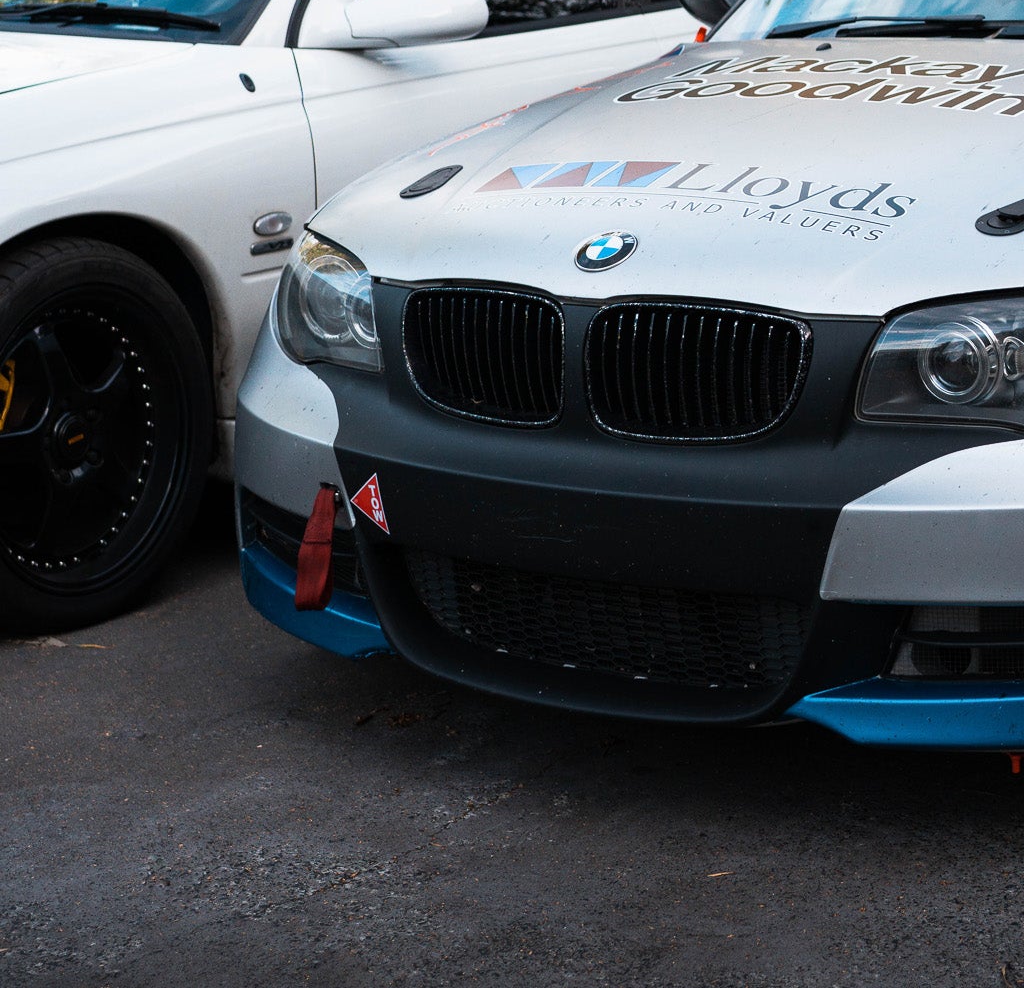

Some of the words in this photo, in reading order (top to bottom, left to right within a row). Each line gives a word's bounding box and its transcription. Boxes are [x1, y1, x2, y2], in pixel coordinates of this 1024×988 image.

[665, 163, 917, 219] Lloyds
[452, 194, 651, 213] CTIONEERS
[660, 199, 723, 214] AND
[742, 207, 884, 242] VALUERS
[367, 484, 384, 522] TOW
